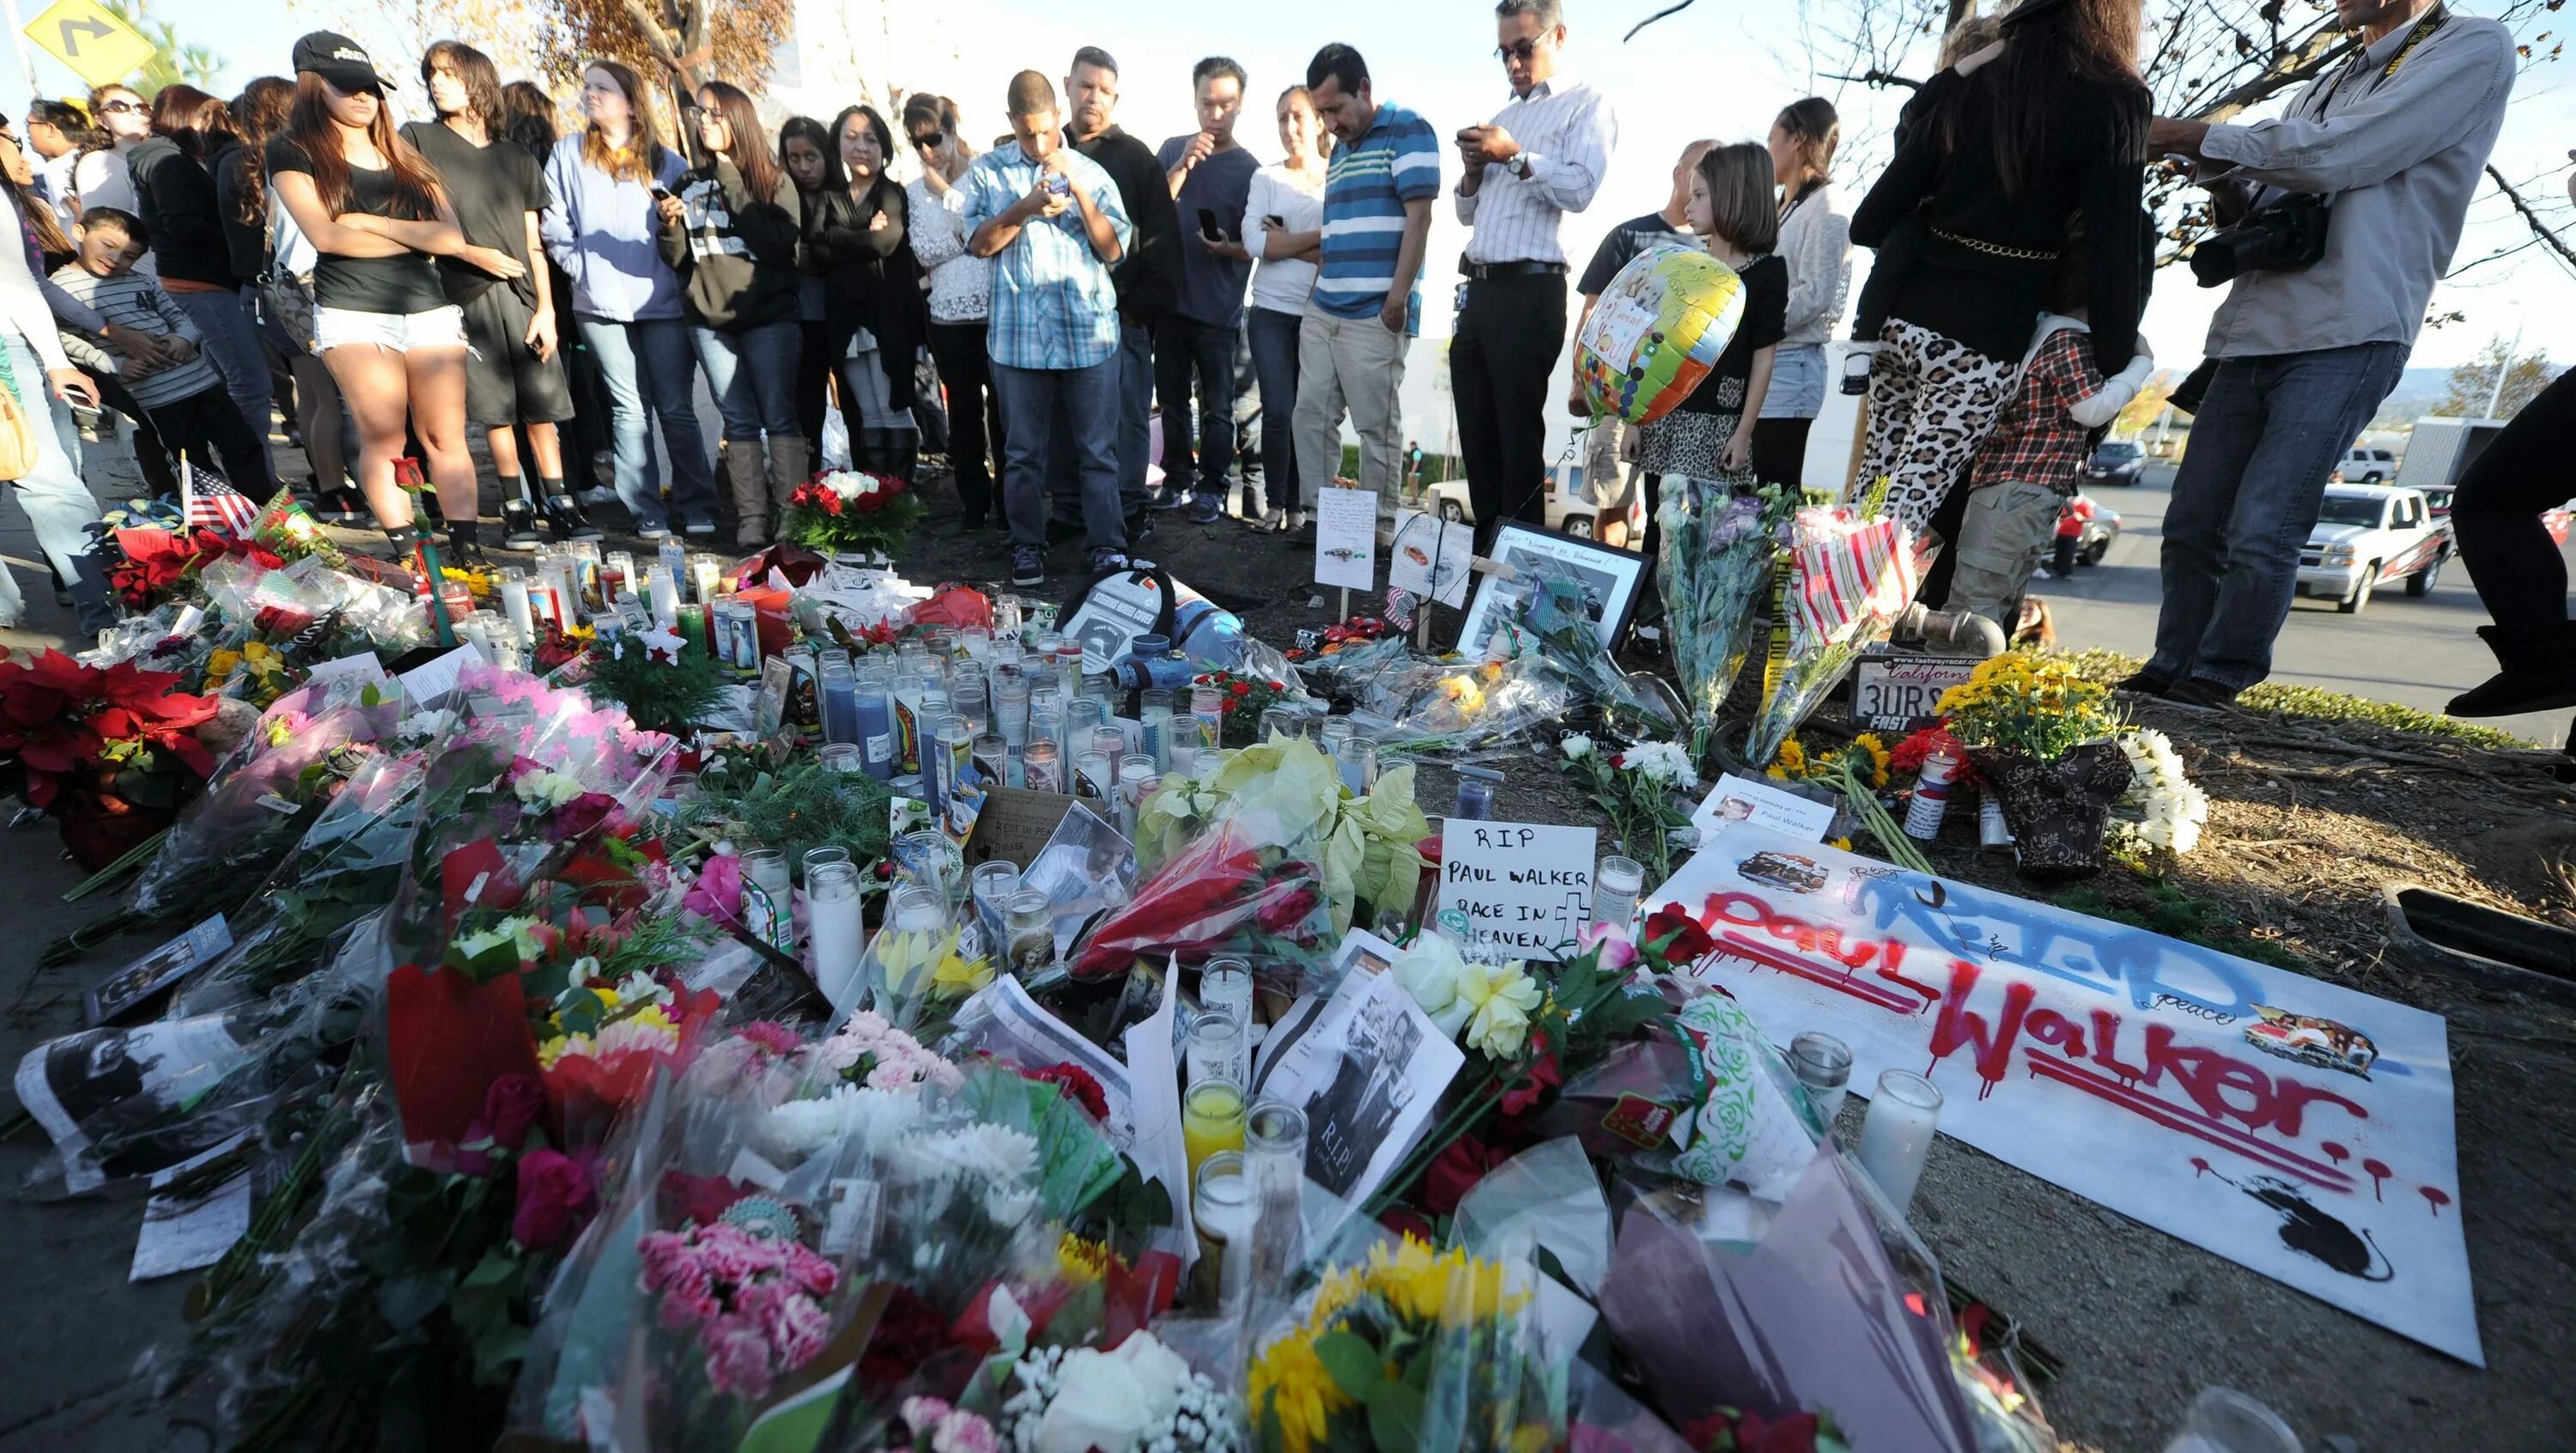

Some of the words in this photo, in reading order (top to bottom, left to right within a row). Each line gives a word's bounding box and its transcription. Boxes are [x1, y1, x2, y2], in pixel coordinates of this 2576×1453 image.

[1116, 601, 1136, 617] WHEEL
[1135, 610, 1154, 625] COVER
[1771, 641, 1787, 660] DO
[1863, 684, 1942, 716] 3URS
[1036, 826, 1055, 836] PEA
[1761, 811, 1782, 822] Paul
[1783, 818, 1814, 832] Walker
[1448, 860, 1496, 884] PAUL
[1457, 899, 1504, 918] RACE
[1516, 906, 1546, 921] IN
[1463, 928, 1546, 947] HEAVEN
